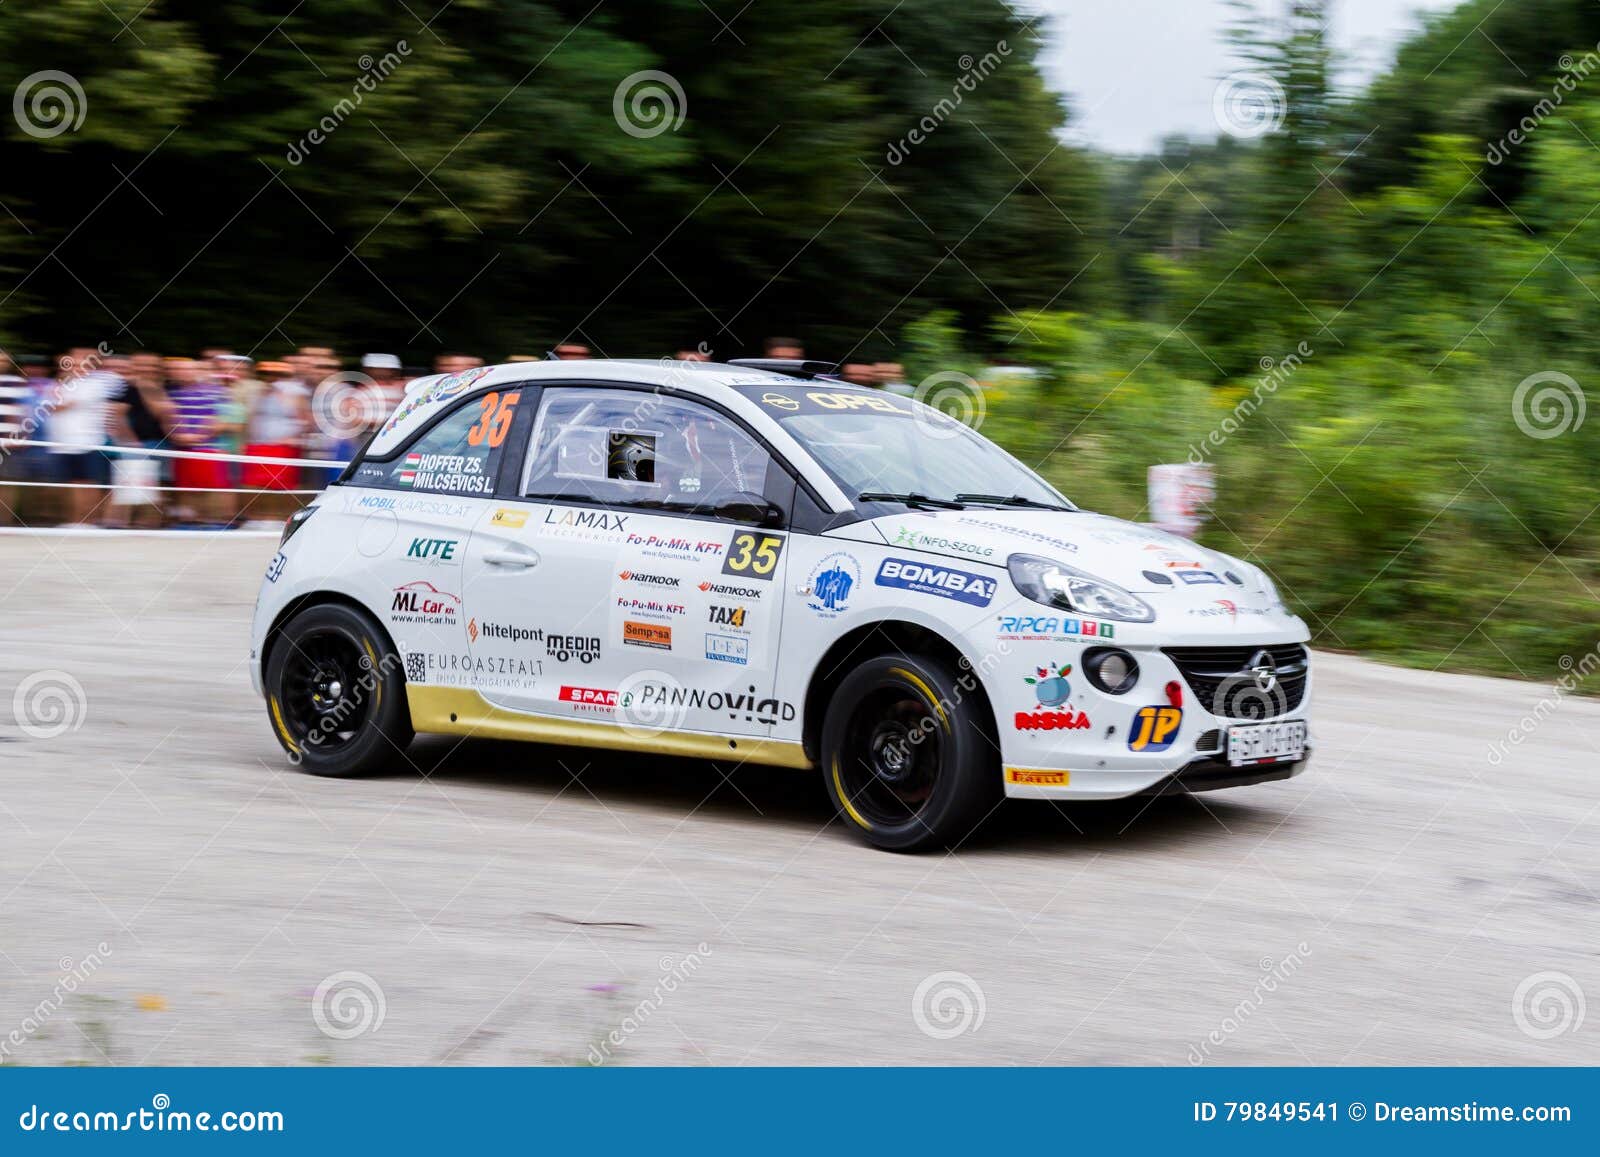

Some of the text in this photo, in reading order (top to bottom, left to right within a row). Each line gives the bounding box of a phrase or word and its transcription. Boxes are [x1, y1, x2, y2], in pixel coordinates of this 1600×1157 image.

[806, 392, 915, 416] OPEL
[468, 392, 521, 448] 35
[418, 453, 482, 474] HOFFER ZS.
[413, 471, 494, 494] MILCSEVICS L.
[545, 508, 629, 532] LAMAX
[407, 537, 458, 560] KITE
[694, 541, 723, 556] KFT.
[728, 534, 781, 575] 35
[918, 534, 993, 557] INFO-SZOLG
[880, 561, 996, 599] BOMBA!
[392, 591, 444, 614] ML-Car
[666, 604, 686, 616] KFT.
[391, 613, 456, 626] www.ml-car.hu
[998, 616, 1058, 634] RIPCA
[482, 622, 544, 643] hitelpont
[546, 634, 600, 651] MEDIA
[428, 653, 543, 676] EUROASZFALT
[546, 649, 600, 664] MOTION
[571, 689, 618, 706] SPAR
[1132, 706, 1182, 751] JP
